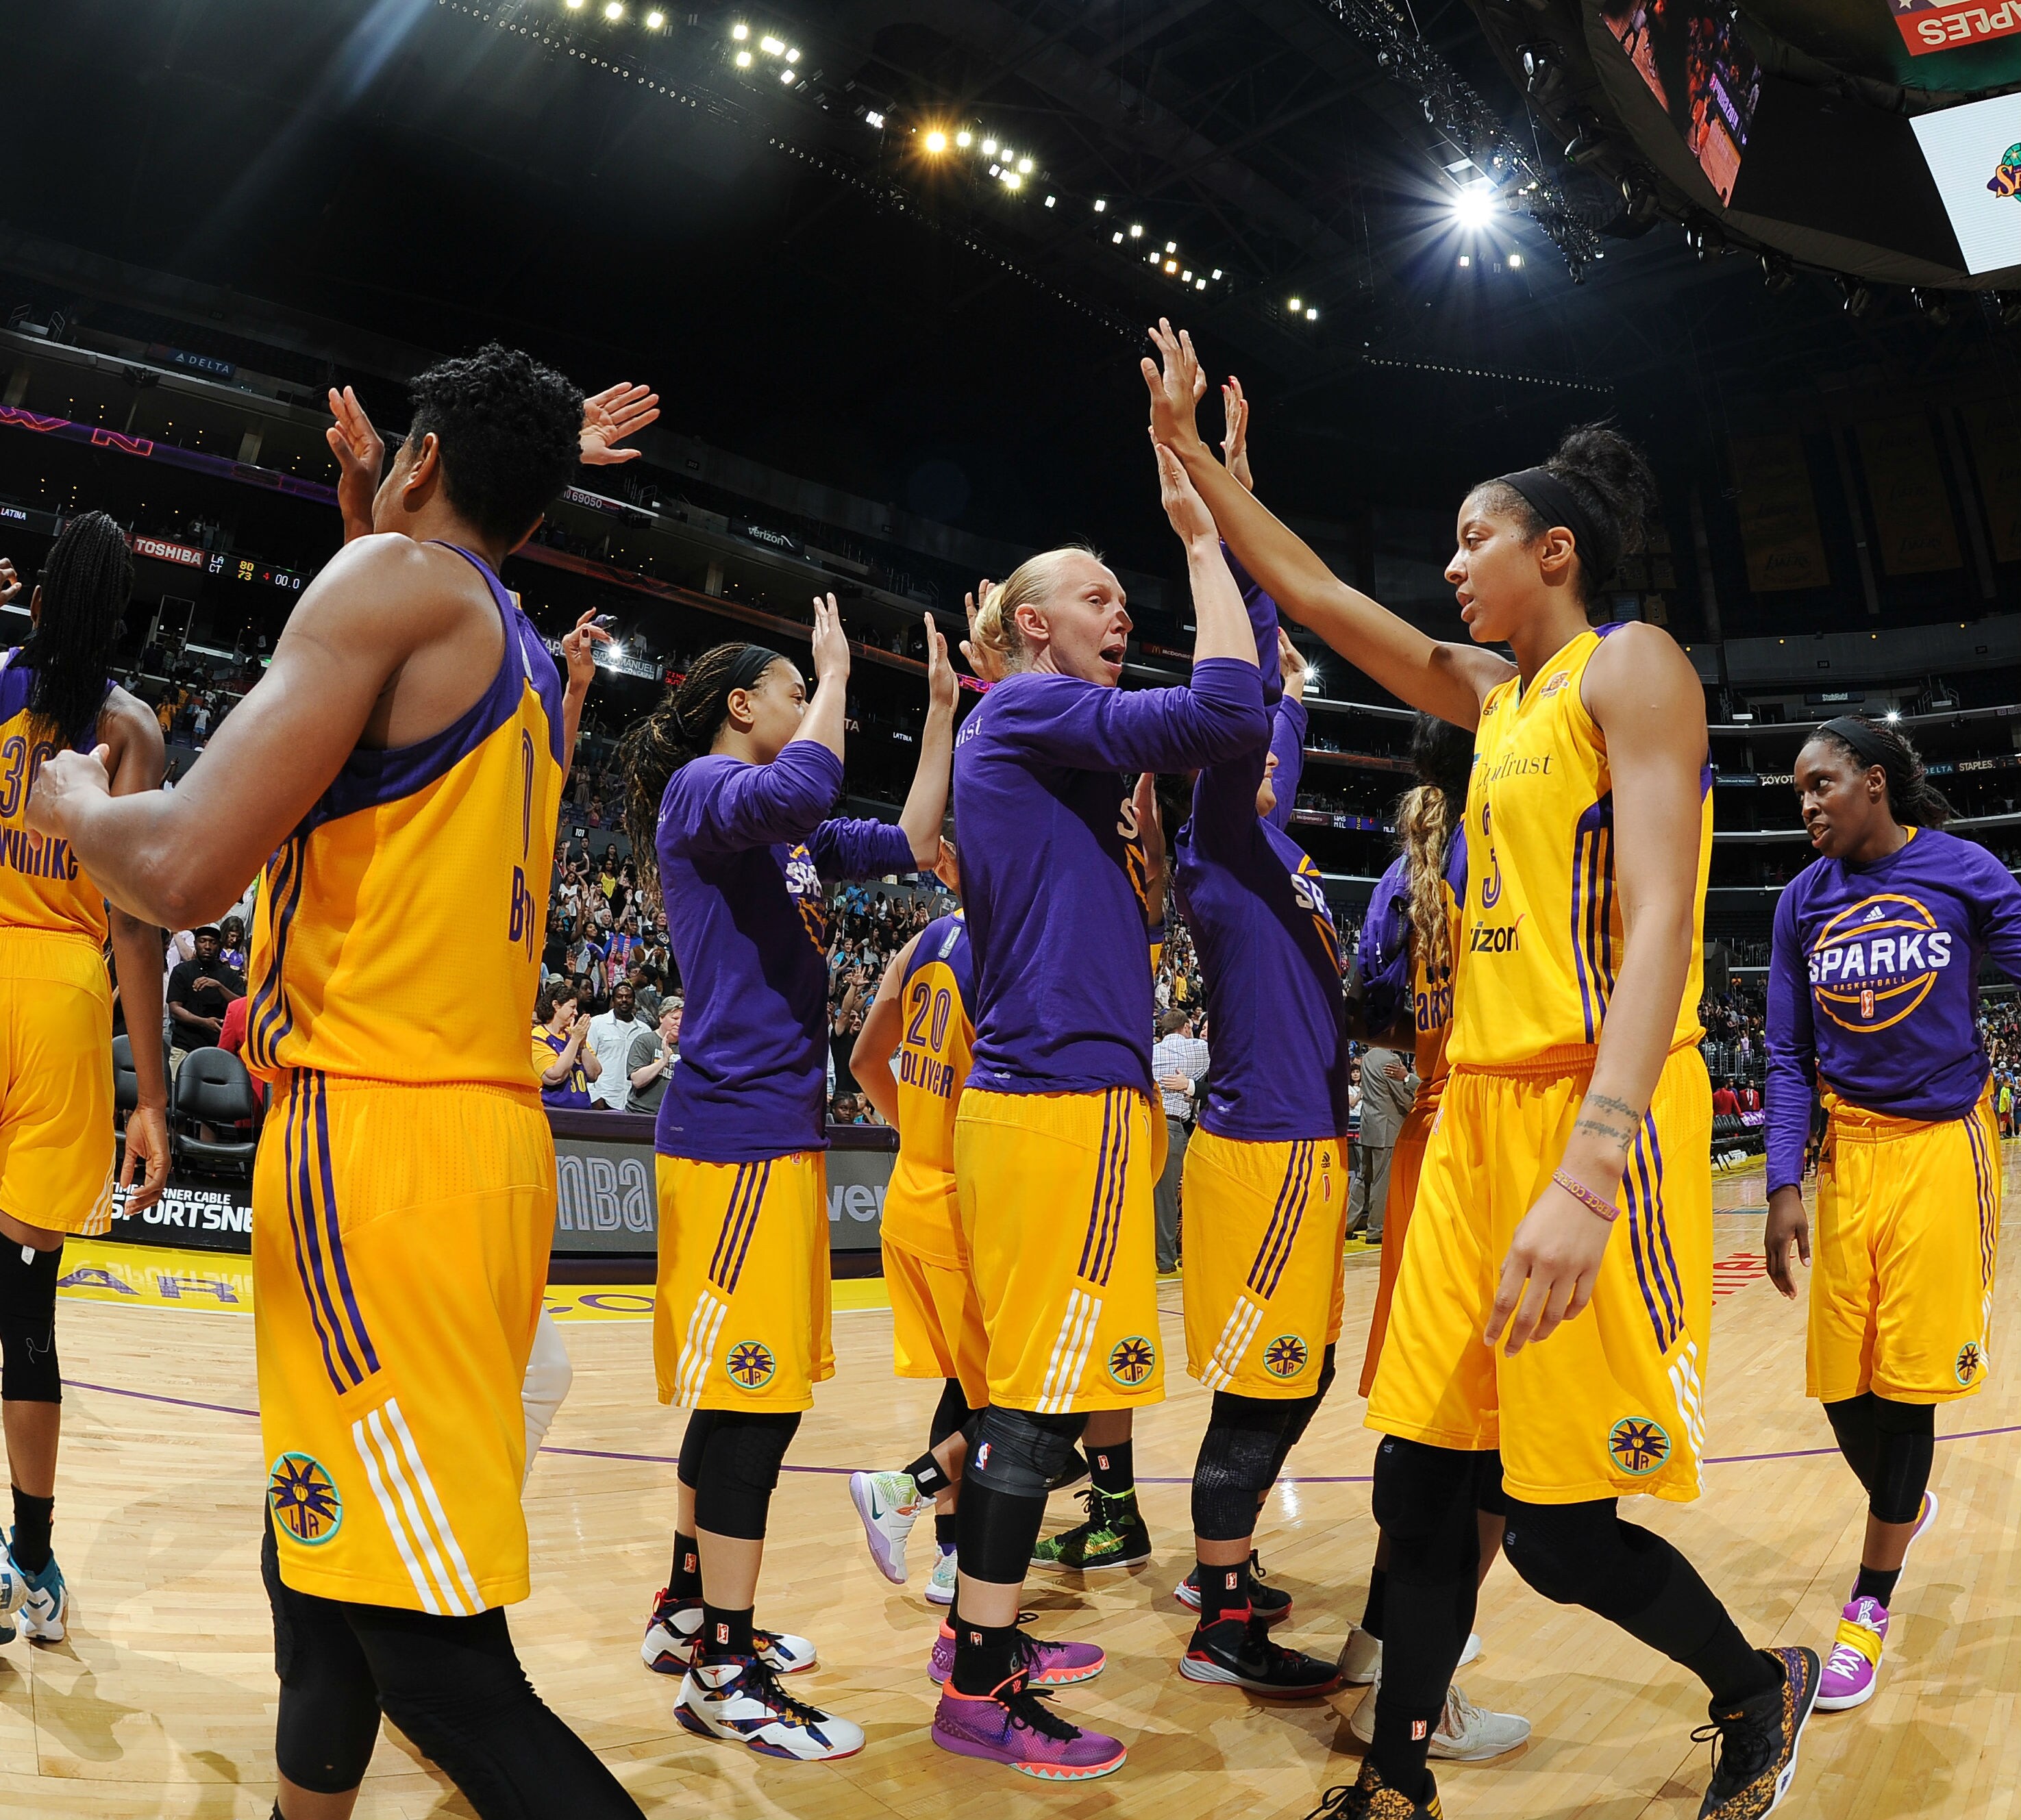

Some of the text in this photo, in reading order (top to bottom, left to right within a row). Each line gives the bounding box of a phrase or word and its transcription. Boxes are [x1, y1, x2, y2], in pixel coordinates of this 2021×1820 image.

[188, 356, 229, 373] DELTA
[571, 491, 603, 509] 69050
[748, 525, 786, 547] verizon
[136, 538, 203, 565] TOSHIBA
[210, 553, 254, 572] LA 80
[208, 563, 252, 581] CT 73
[275, 573, 300, 589] 00.0
[618, 656, 655, 674] MANUEL
[1807, 932, 1952, 982] SPARKS
[1833, 975, 1907, 992] BASKETBALL
[906, 982, 952, 1054] 20
[194, 1191, 232, 1206] CABLE
[1585, 1193, 1617, 1218] FIERCE
[290, 1509, 320, 1536] LA
